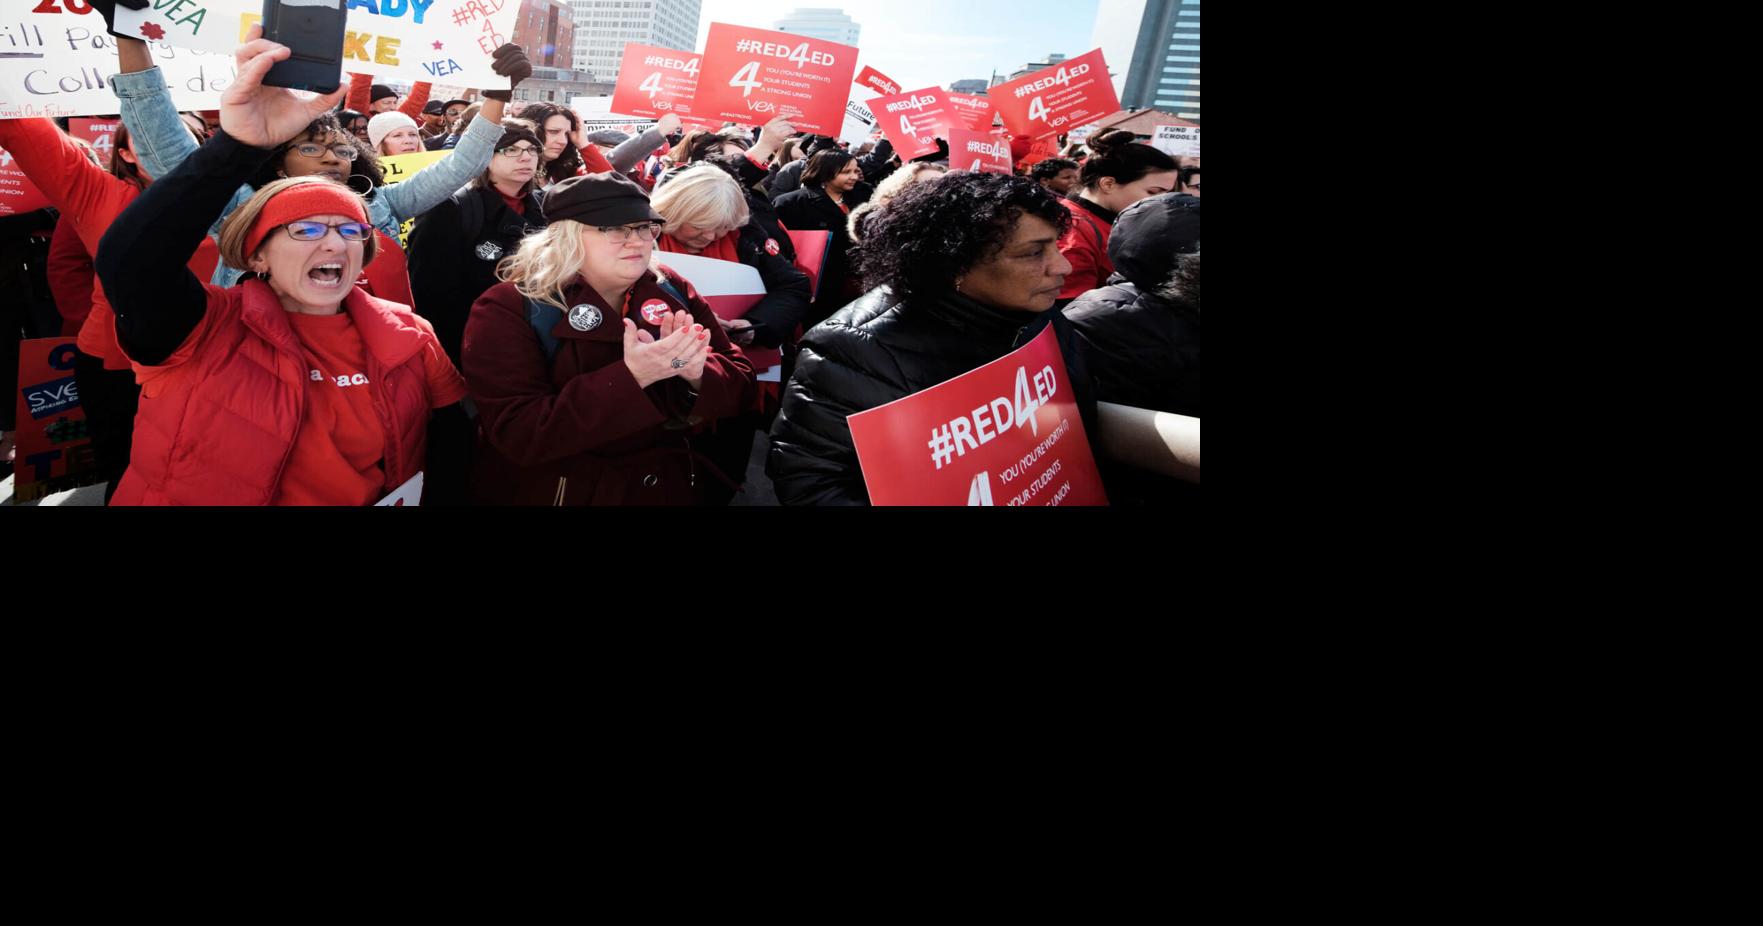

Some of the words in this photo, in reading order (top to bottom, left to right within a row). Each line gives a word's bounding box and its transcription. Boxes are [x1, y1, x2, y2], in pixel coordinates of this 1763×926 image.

[422, 58, 463, 77] VEA
[736, 39, 835, 69] #RED4ED
[639, 71, 663, 99] 4
[729, 61, 762, 97] 4
[1014, 63, 1090, 98] #RED4ED
[847, 100, 876, 121] Future
[886, 94, 937, 112] #RED4ED
[1028, 96, 1052, 122] 4
[900, 115, 917, 138] 4
[927, 365, 1057, 470] #RED4ED
[999, 464, 1019, 485] YOU
[1030, 459, 1062, 496] STUDENTS
